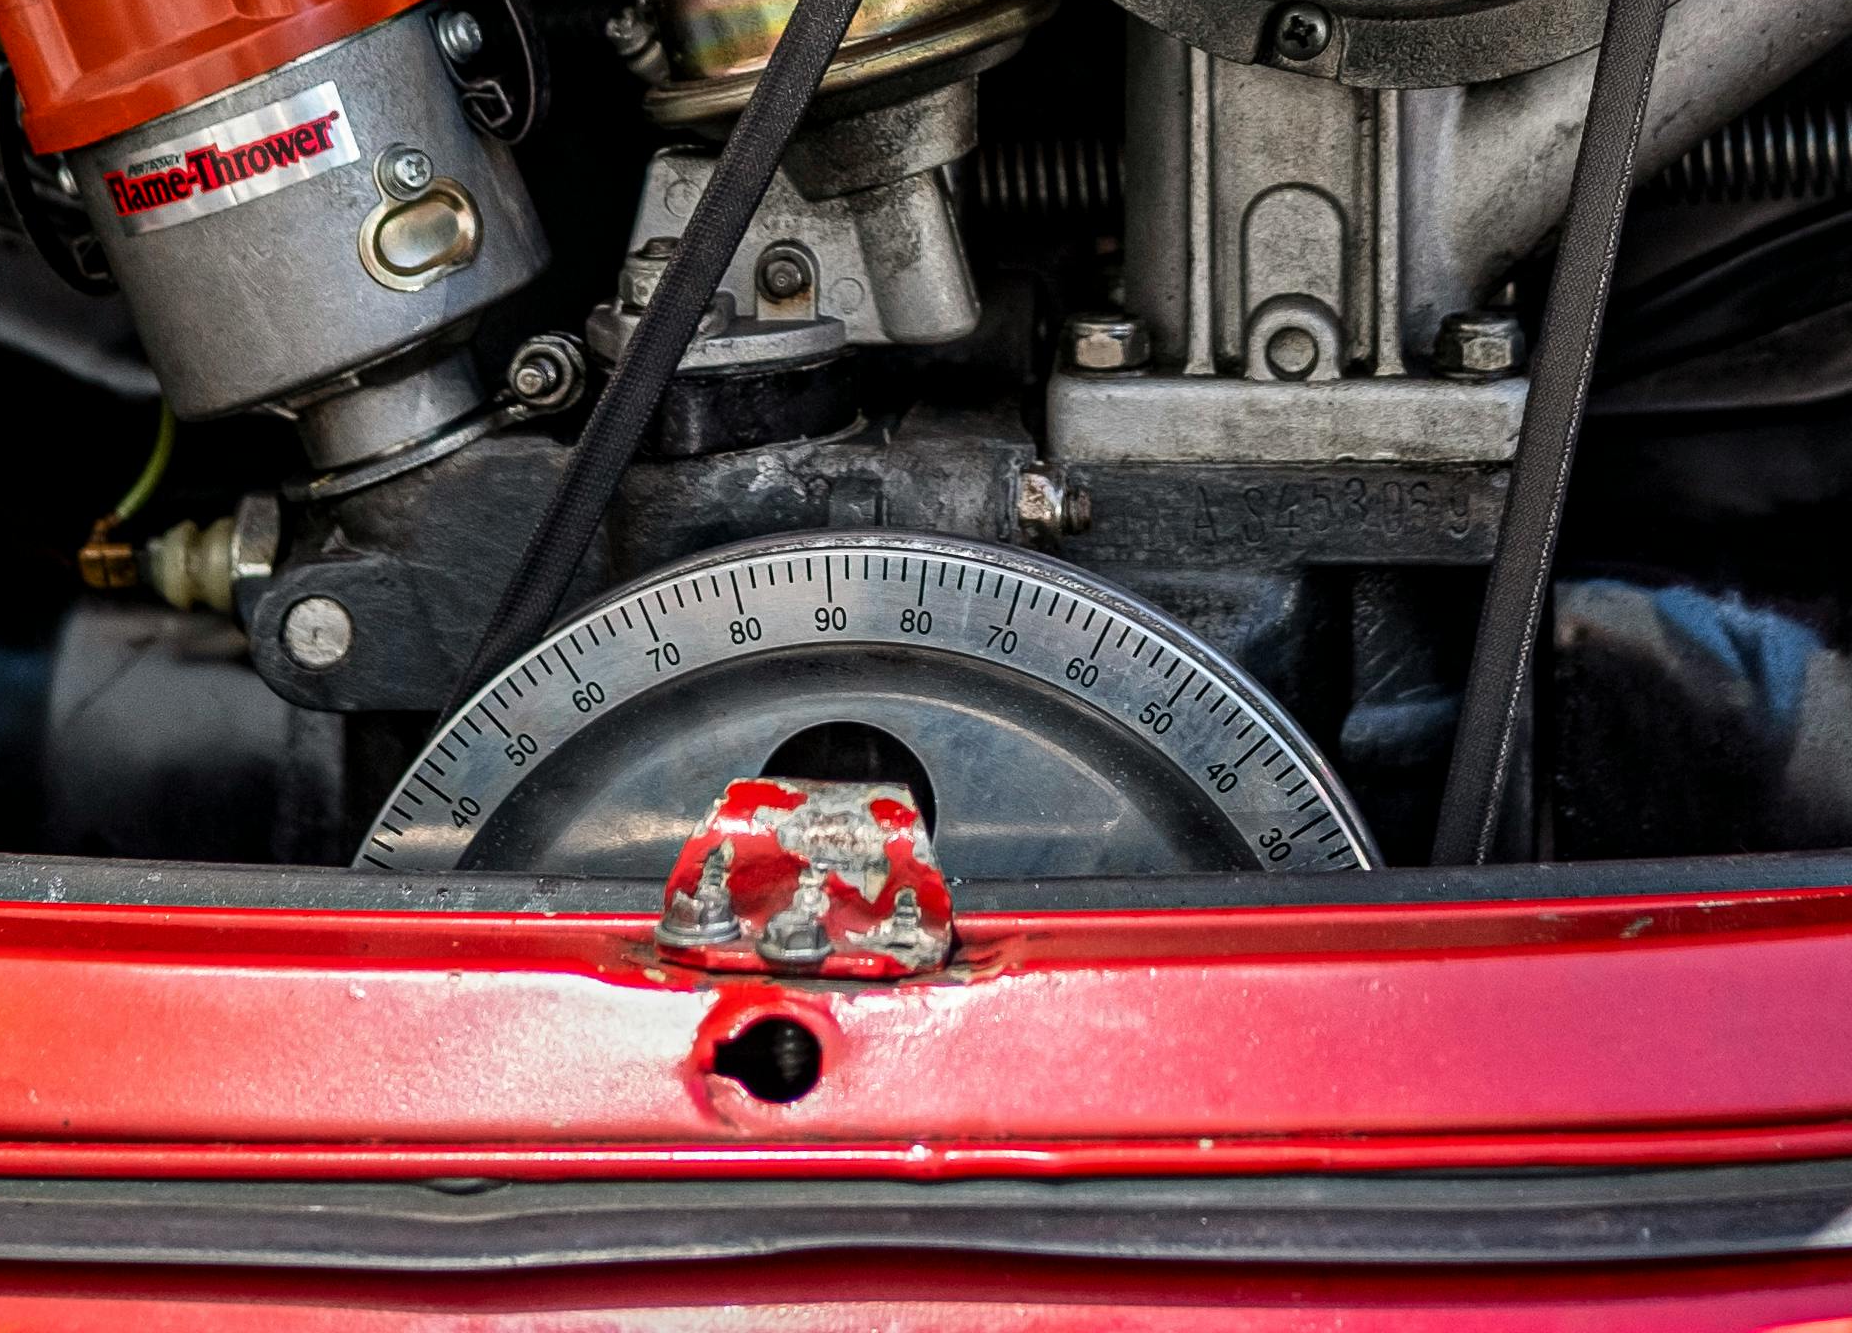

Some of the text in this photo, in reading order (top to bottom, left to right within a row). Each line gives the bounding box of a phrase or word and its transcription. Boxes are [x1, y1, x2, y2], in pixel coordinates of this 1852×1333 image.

[109, 118, 335, 214] Flame-Thrower
[450, 605, 1293, 863] 40 50 60 70 80 90 80 70 60 50 40 30
